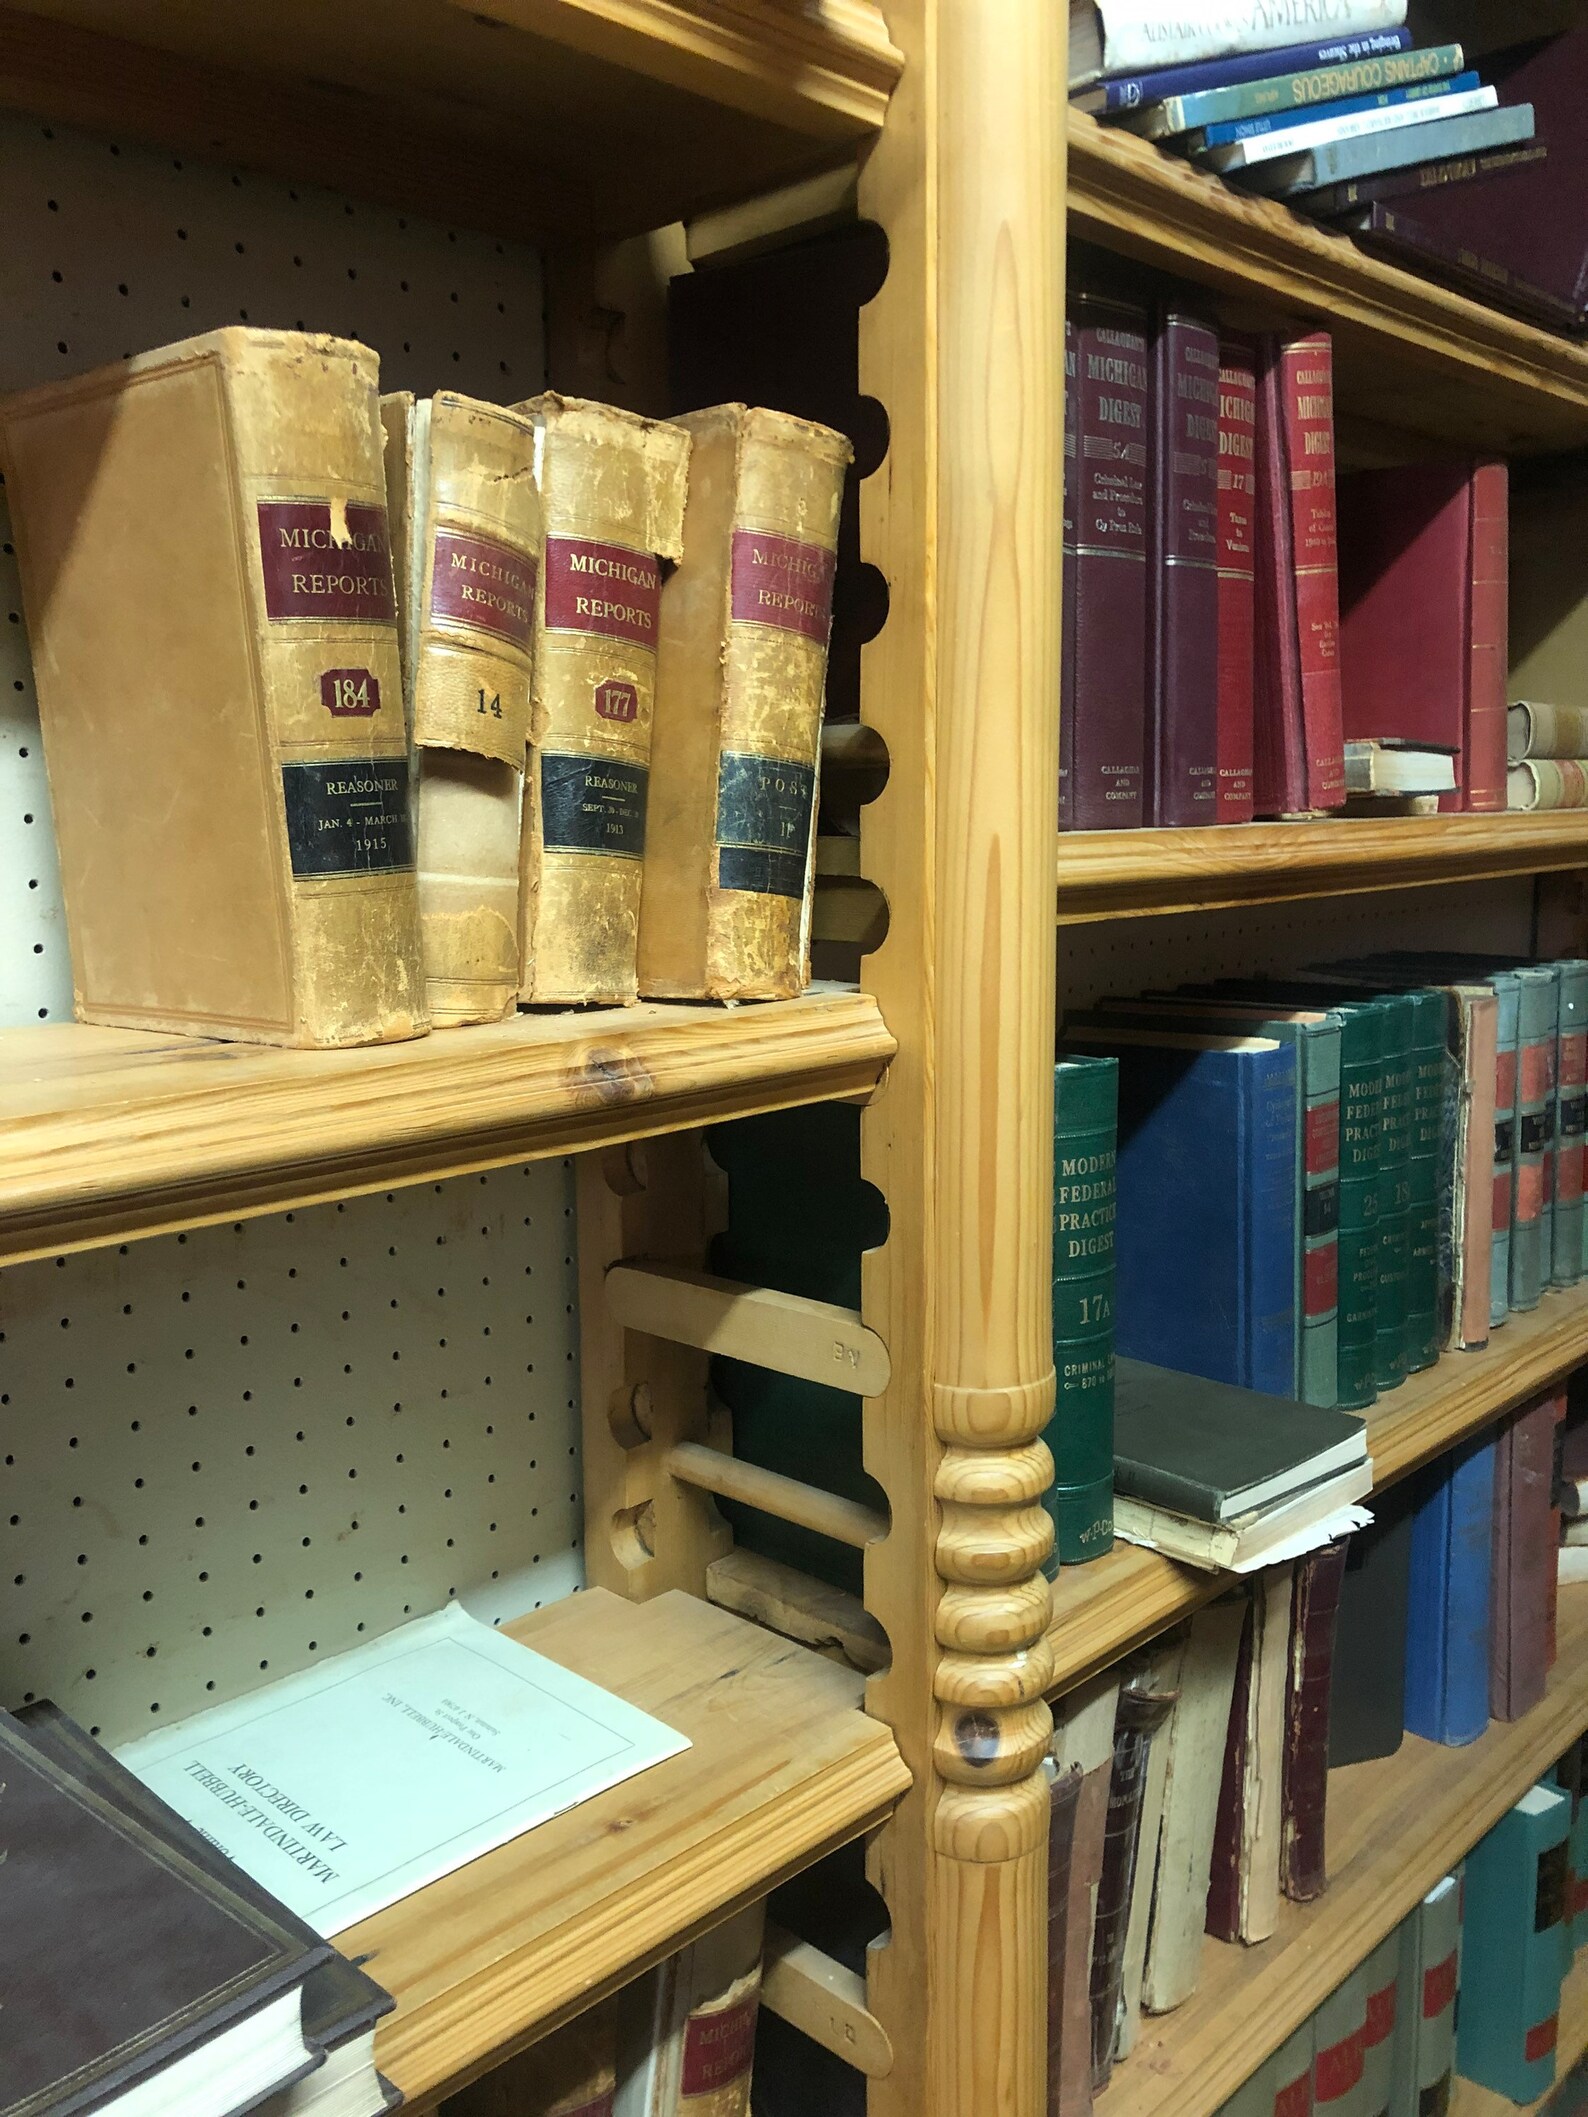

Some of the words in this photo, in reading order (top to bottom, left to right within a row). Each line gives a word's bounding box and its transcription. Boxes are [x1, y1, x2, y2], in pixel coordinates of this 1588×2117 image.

[1292, 62, 1383, 103] COURAGEOUS
[1384, 52, 1440, 83] CAPTAINS
[1098, 395, 1141, 429] DIGEST
[1232, 473, 1245, 490] 17
[450, 552, 535, 601] MICHIGAN
[569, 553, 657, 591] MICHIGAN
[752, 548, 826, 583] MICHIG
[291, 574, 389, 597] REPORTS
[461, 583, 529, 624] REPORTS
[575, 596, 653, 630] REPORTS
[333, 678, 370, 709] 184
[476, 687, 503, 720] 14
[604, 688, 631, 718] 177
[325, 778, 399, 796] REASONER
[584, 775, 639, 794] REASONER
[318, 818, 343, 832] JAN.
[364, 813, 399, 827] MARCH
[606, 822, 624, 835] 1913
[356, 837, 388, 852] 1915
[1059, 1176, 1117, 1204] FEDERAL
[1068, 1230, 1114, 1258] DIGEST
[227, 1763, 312, 1823] DIRECTORY
[183, 1759, 341, 1885] MARTINDALE-HUBBELL
[301, 1822, 349, 1852] LAW
